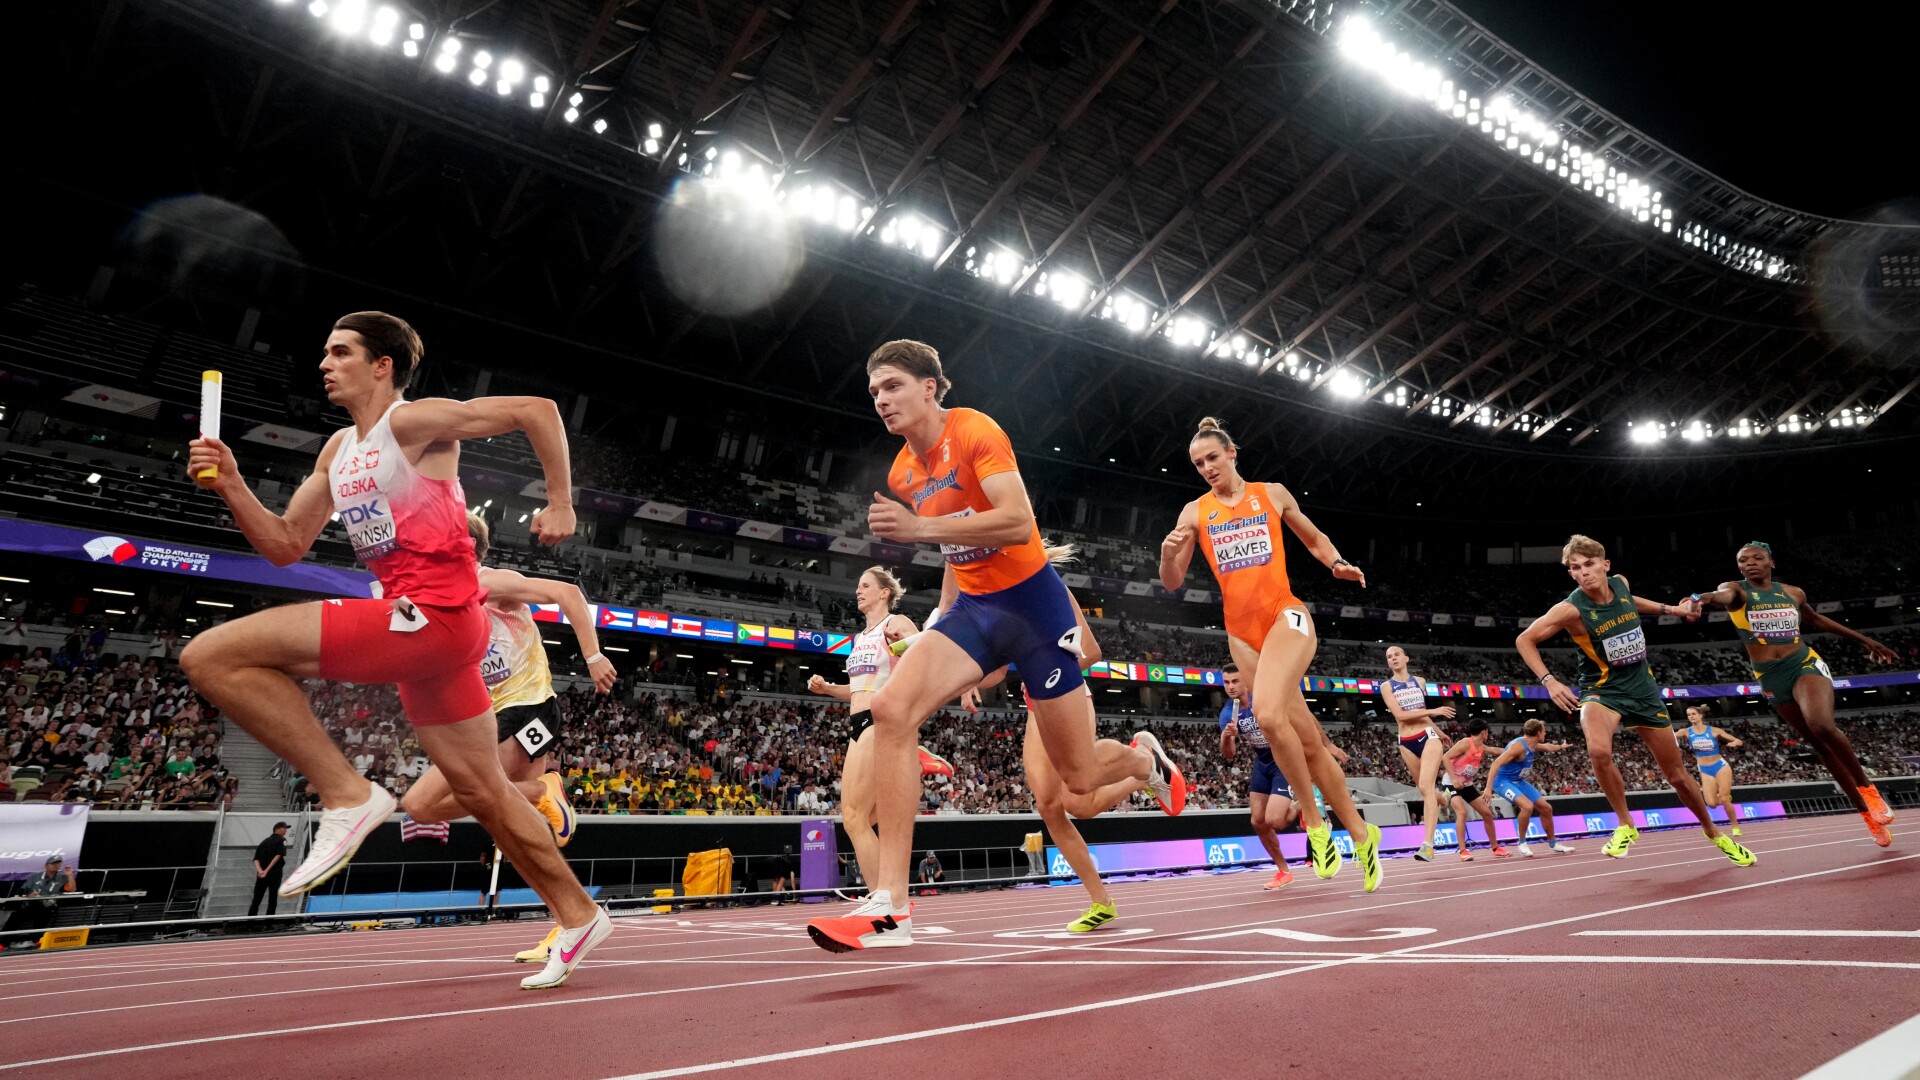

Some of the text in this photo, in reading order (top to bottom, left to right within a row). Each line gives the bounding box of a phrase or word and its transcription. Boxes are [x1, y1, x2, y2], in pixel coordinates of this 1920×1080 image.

[340, 500, 384, 527] TDK
[1206, 511, 1268, 535] Nederland
[1212, 528, 1267, 545] HONDA
[142, 551, 208, 566] CHAMPIONSHIPS
[144, 545, 210, 560] WORLD ATHLETICS
[1216, 541, 1268, 562] KLAVER
[1291, 612, 1302, 628] 7
[1750, 610, 1797, 620] HONDA
[1595, 619, 1617, 636] SOUTH
[526, 727, 543, 746] 8
